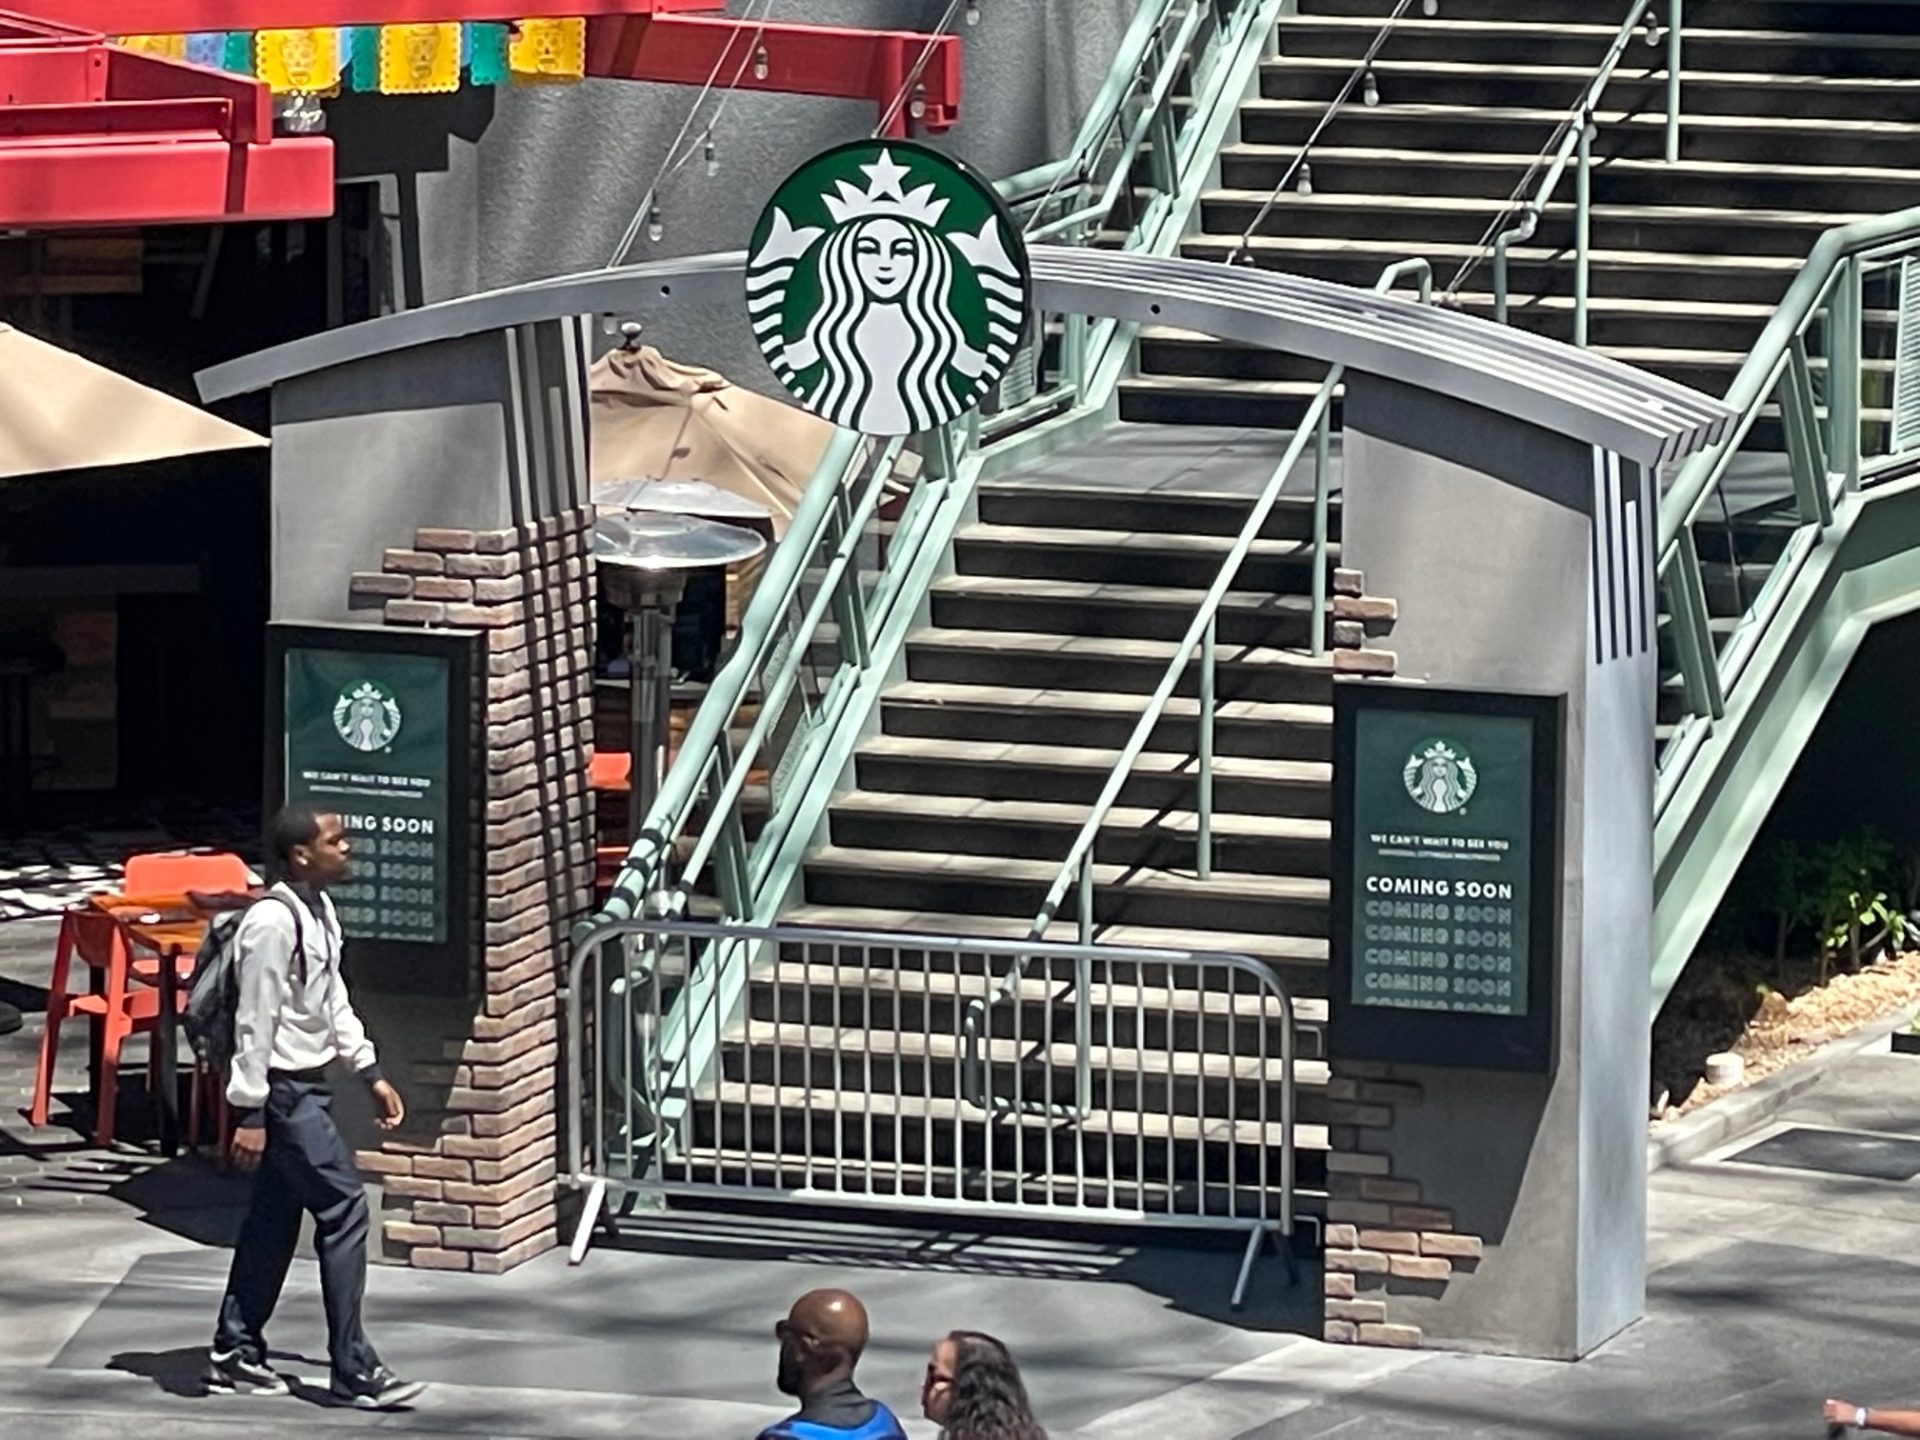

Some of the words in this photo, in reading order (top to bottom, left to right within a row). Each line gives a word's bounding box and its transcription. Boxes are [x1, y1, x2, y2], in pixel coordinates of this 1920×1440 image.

[378, 775, 390, 784] TO
[381, 816, 434, 834] SOON
[1371, 834, 1387, 844] WE
[1389, 834, 1419, 845] CAN'T
[1422, 837, 1449, 846] WAIT
[1452, 837, 1465, 848] TO
[1467, 838, 1484, 849] SEE
[1487, 840, 1509, 851] YOU
[1366, 876, 1450, 896] COMING
[1455, 880, 1513, 900] SOON
[1365, 901, 1450, 920] COMING
[1453, 905, 1513, 925] SOON
[1365, 924, 1450, 944] COMING
[1453, 928, 1513, 949] SOON
[1365, 948, 1450, 969] COMING
[1453, 953, 1513, 973] SOON
[1365, 972, 1450, 993] COMING
[1453, 977, 1513, 997] SOON
